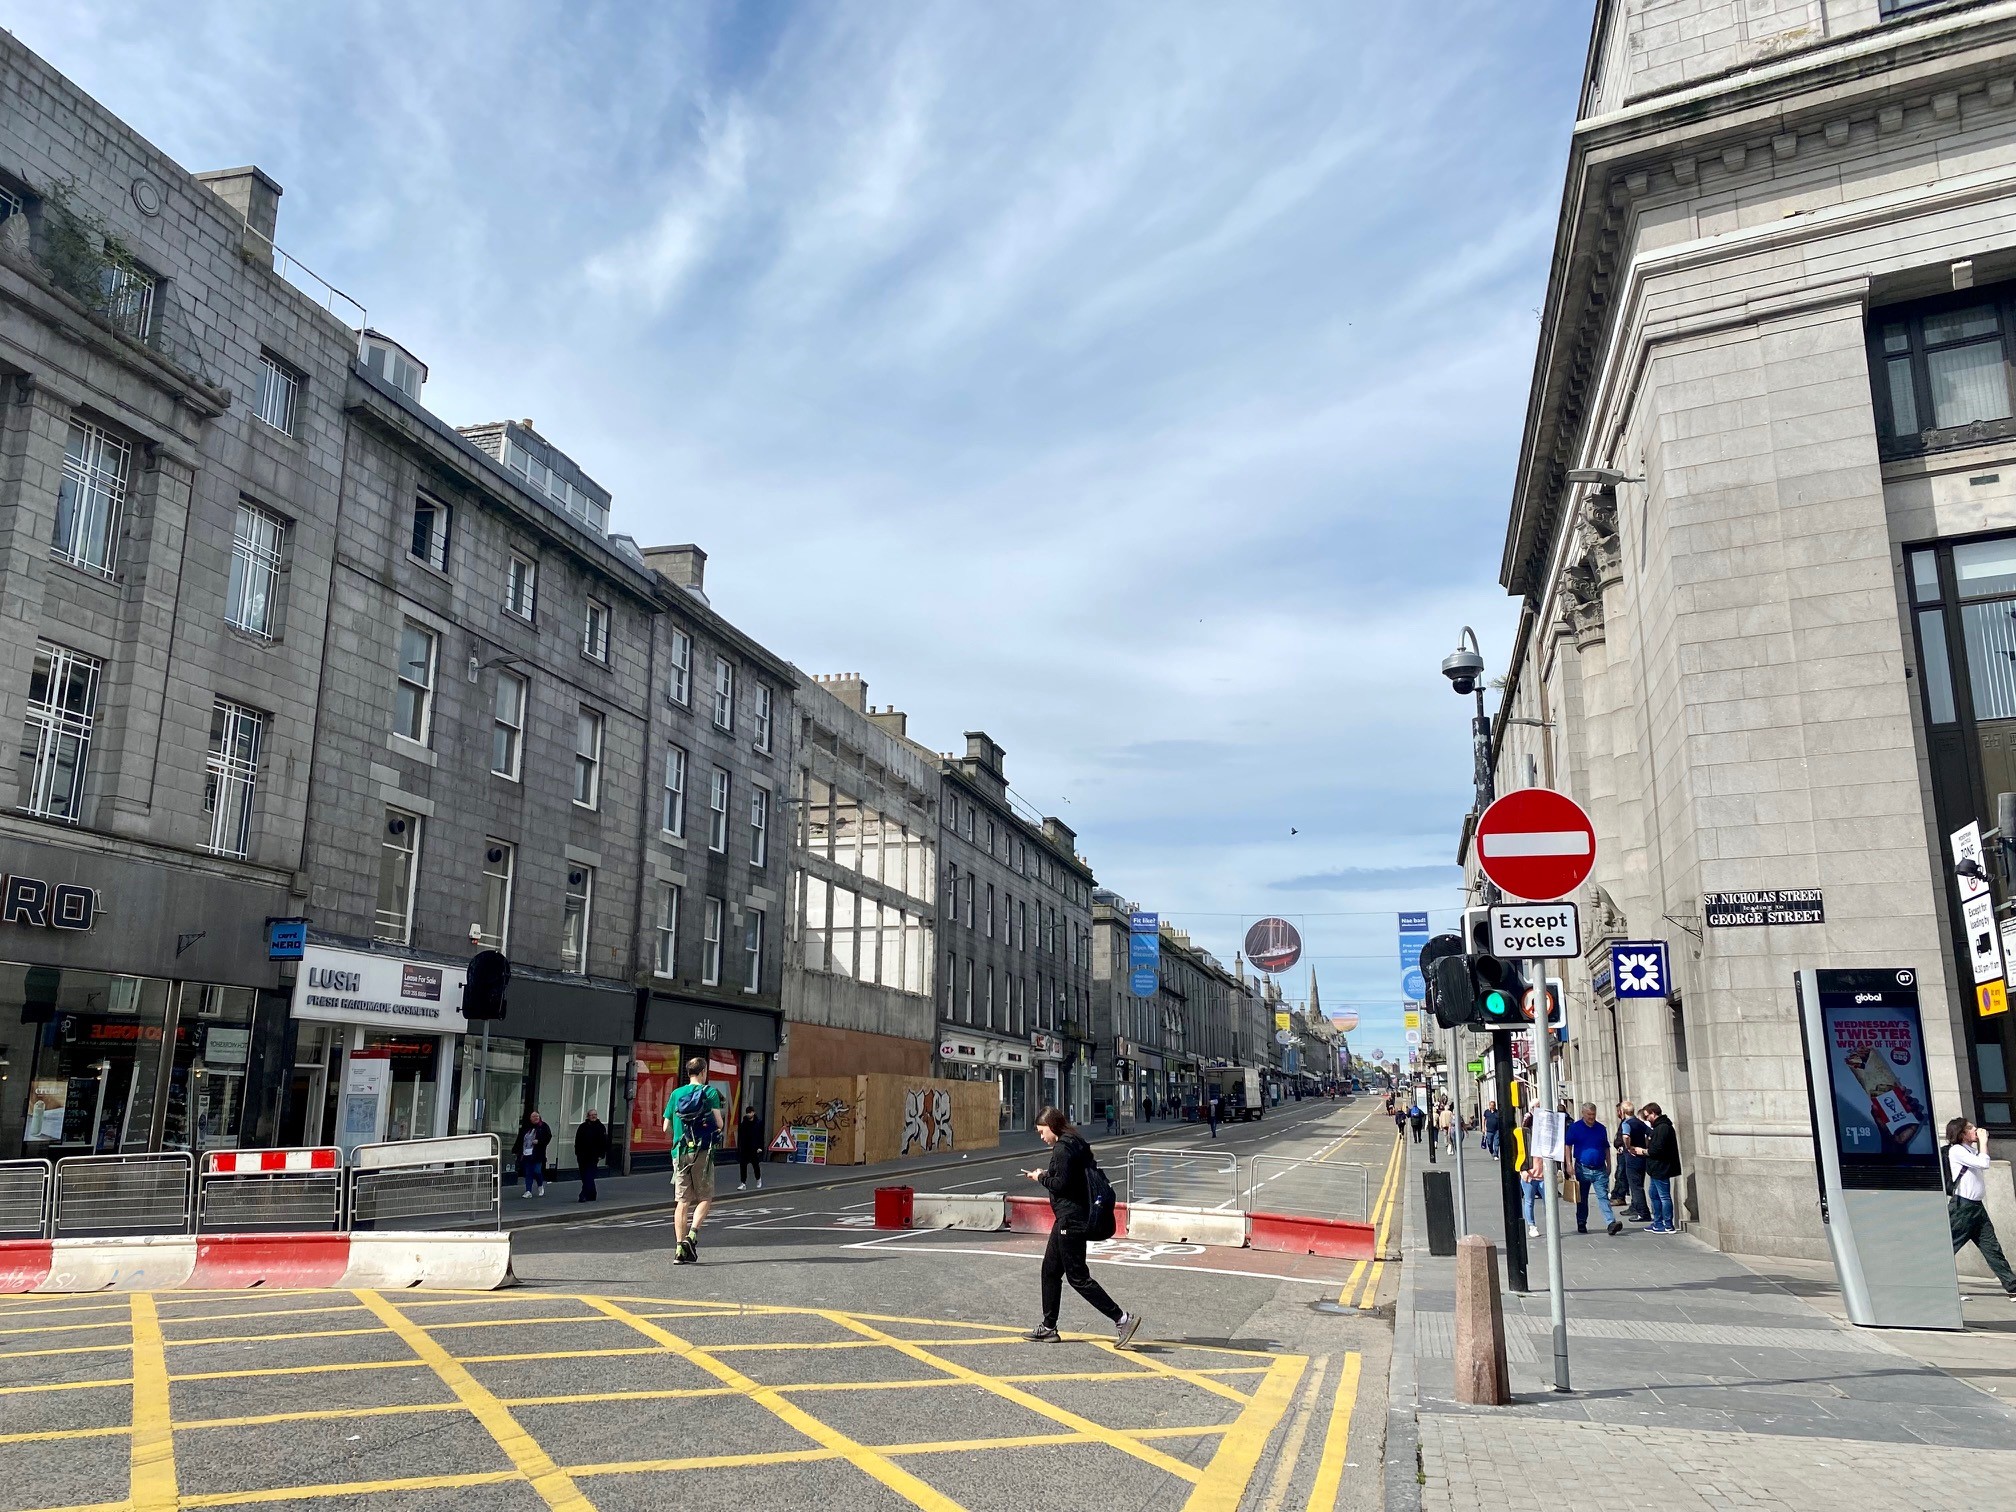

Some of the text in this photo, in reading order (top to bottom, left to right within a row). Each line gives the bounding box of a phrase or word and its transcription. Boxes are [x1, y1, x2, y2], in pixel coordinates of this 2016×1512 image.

[1779, 889, 1822, 902] STREET
[0, 872, 95, 931] RO
[1743, 904, 1772, 912] leading
[1500, 912, 1568, 930] Except
[1709, 910, 1821, 925] GEORGE STREET
[271, 941, 302, 949] NERO
[1504, 933, 1566, 951] cycles
[309, 967, 360, 992] LUSH
[417, 974, 426, 983] For
[425, 976, 437, 985] Sale
[1900, 974, 1910, 982] BT
[1855, 993, 1882, 1004] global
[306, 994, 441, 1019] FRESH HANDMADE COSMETICS
[1833, 1020, 1910, 1029] WEDNESDAY'S
[1834, 1029, 1912, 1040] TWISTER
[1836, 1040, 1911, 1049] WRAP OF THE DAY
[1892, 1111, 1906, 1121] KFC
[1846, 1127, 1871, 1145] £1.98
